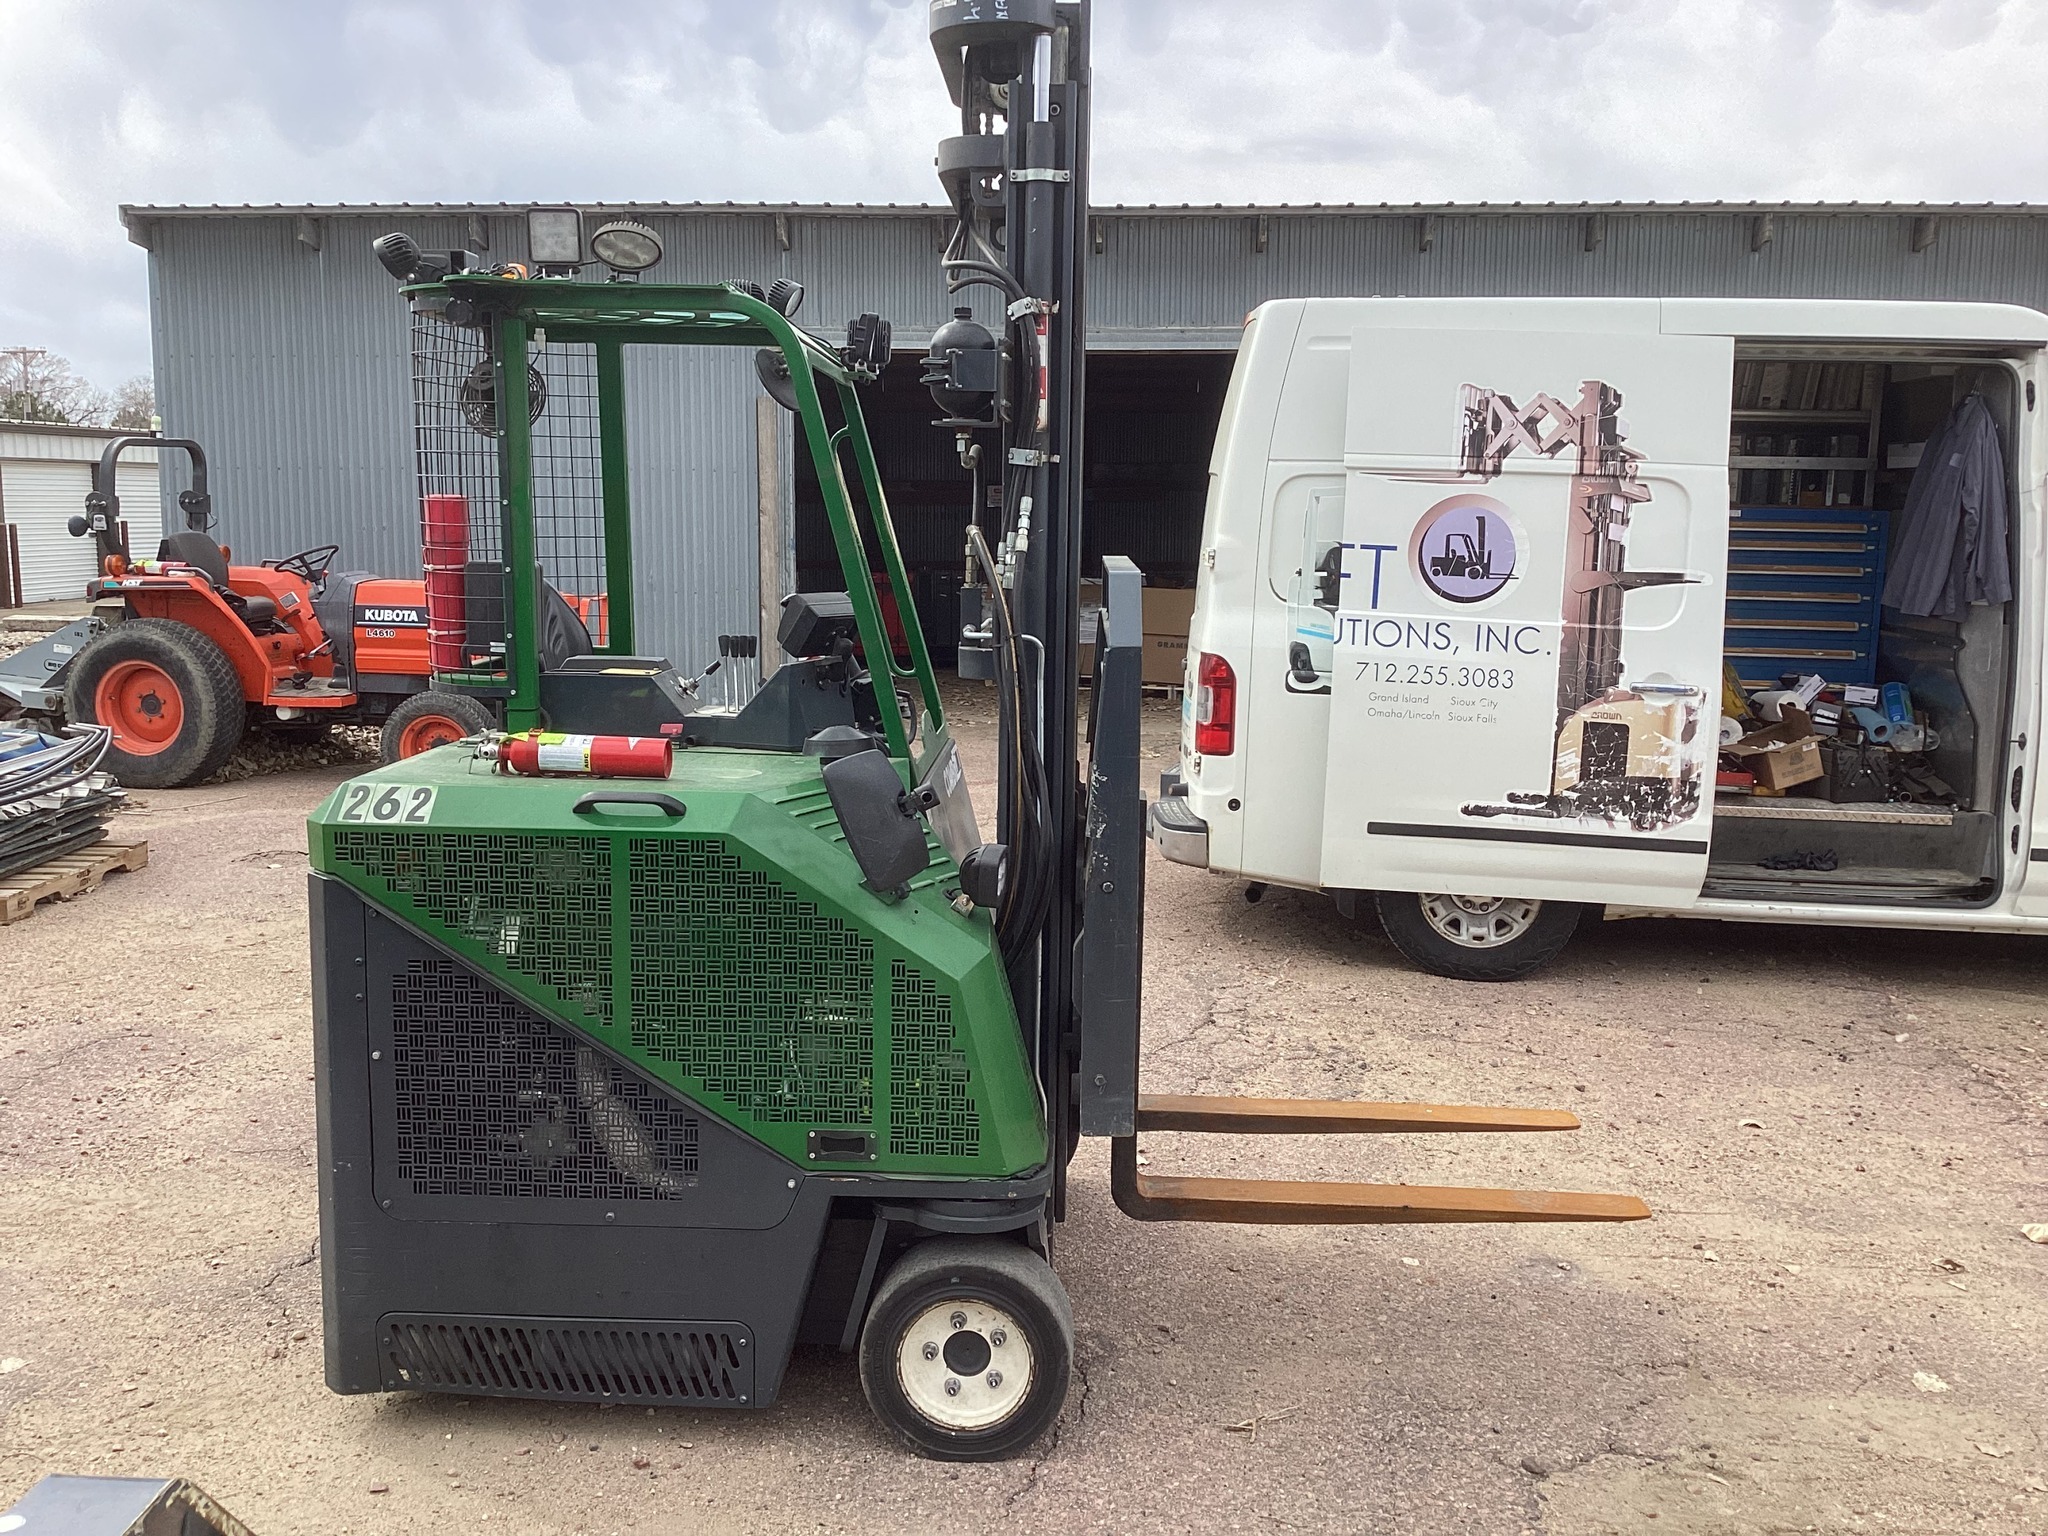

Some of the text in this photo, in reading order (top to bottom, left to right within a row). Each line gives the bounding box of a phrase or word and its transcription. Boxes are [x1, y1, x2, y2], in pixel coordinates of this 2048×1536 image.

[121, 579, 143, 587] HST
[1340, 543, 1398, 610] T
[364, 608, 419, 622] KUBOTA
[366, 628, 396, 638] L4610
[1476, 624, 1552, 656] INC.
[1355, 662, 1514, 689] 712.255.3083
[1368, 691, 1429, 704] Grand Island
[1450, 696, 1498, 710] Sioux City
[1367, 707, 1440, 720] Omaha/Lincoln
[1448, 711, 1497, 724] Sioux Falls
[342, 785, 432, 822] 262
